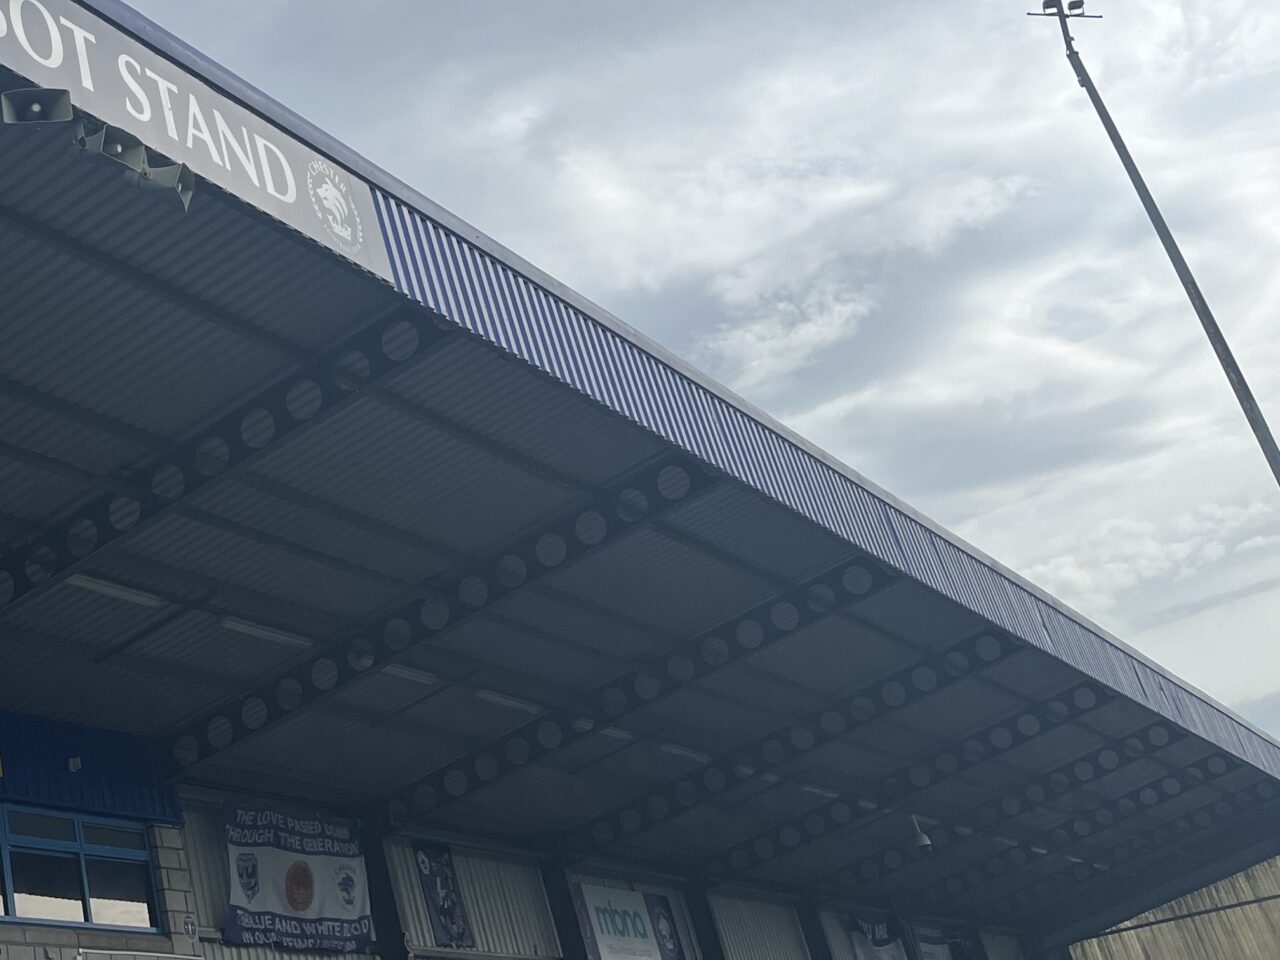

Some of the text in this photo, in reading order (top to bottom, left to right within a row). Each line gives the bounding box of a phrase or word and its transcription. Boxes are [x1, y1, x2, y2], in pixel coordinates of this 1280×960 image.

[117, 53, 297, 204] STAND
[236, 809, 255, 825] THE
[257, 810, 285, 828] LOVE
[225, 824, 274, 843] THROUGH
[278, 831, 301, 849] THE
[275, 917, 301, 935] AND
[303, 920, 342, 938] WHITE
